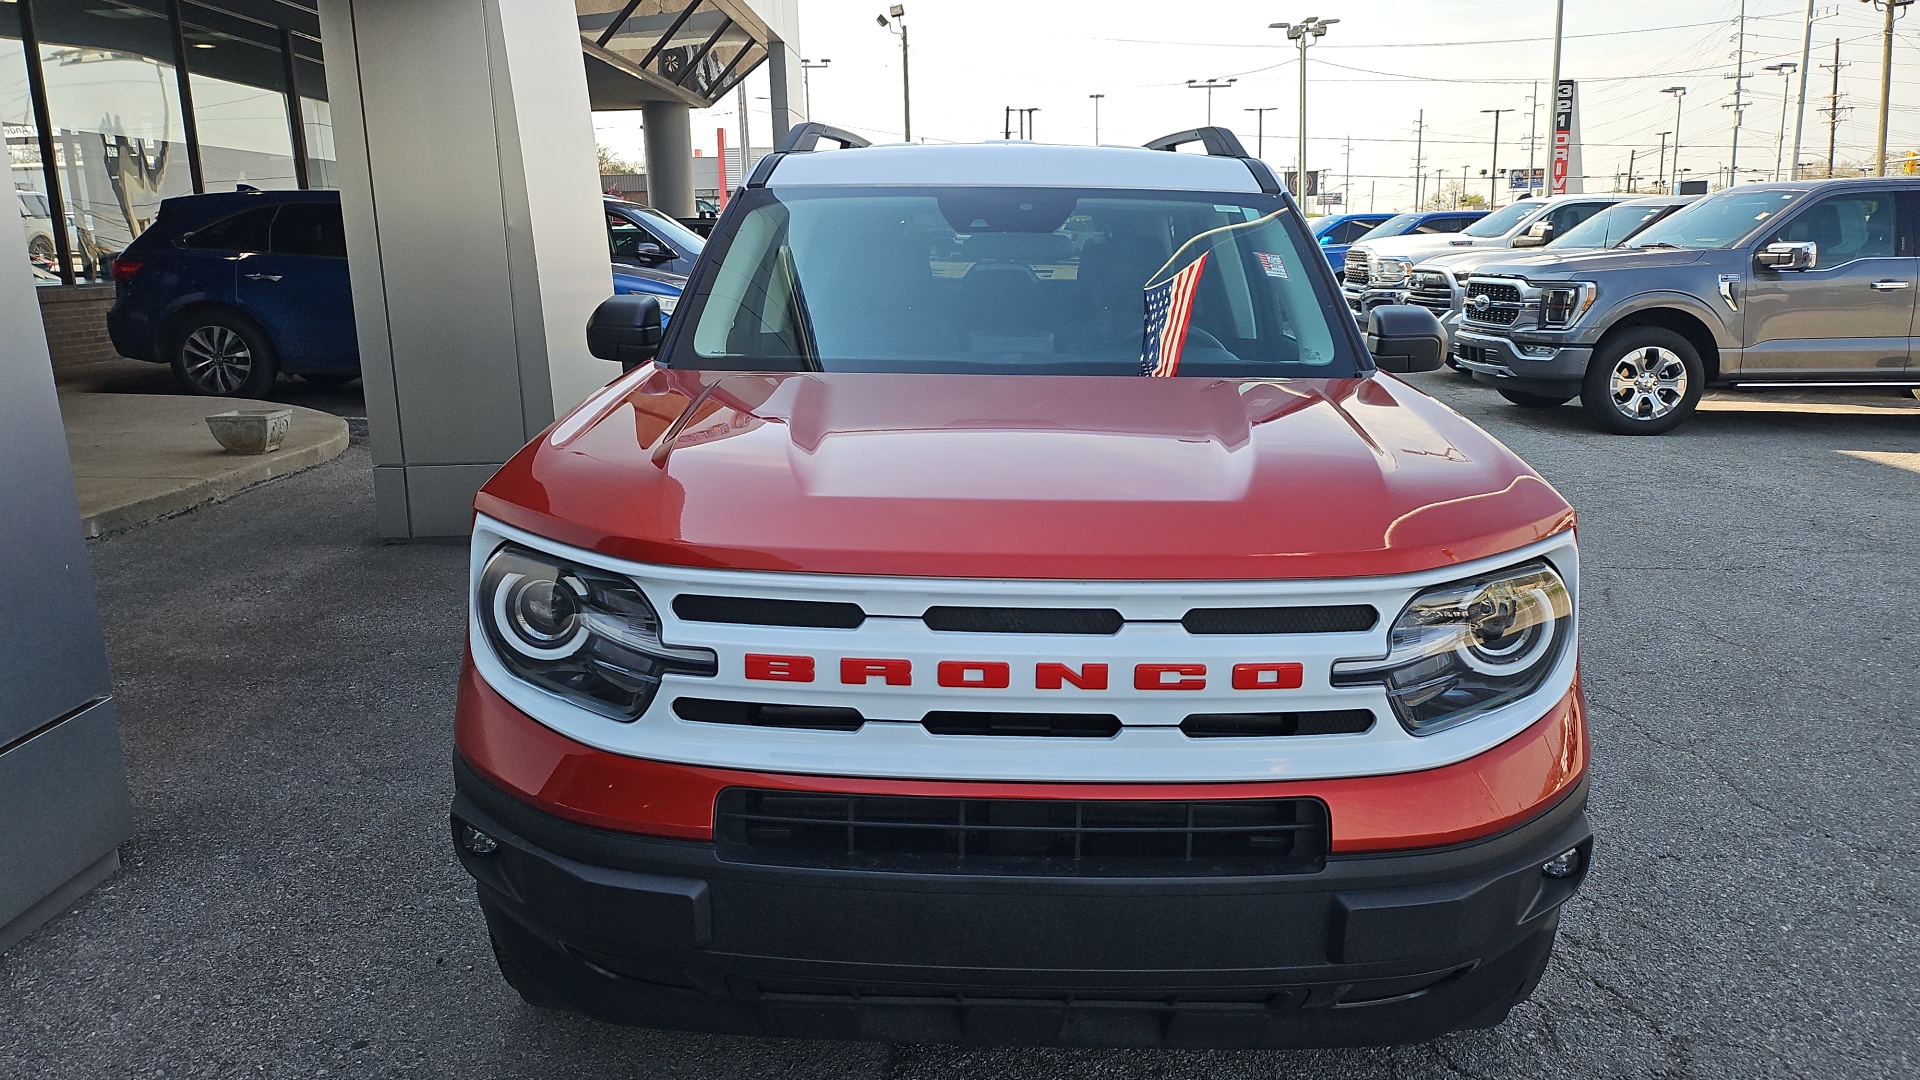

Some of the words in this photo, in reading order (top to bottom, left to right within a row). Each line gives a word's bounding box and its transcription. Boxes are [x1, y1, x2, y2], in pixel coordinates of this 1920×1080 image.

[1557, 84, 1573, 127] 321
[1553, 133, 1569, 193] DRIV
[744, 653, 1304, 691] BRONCO
